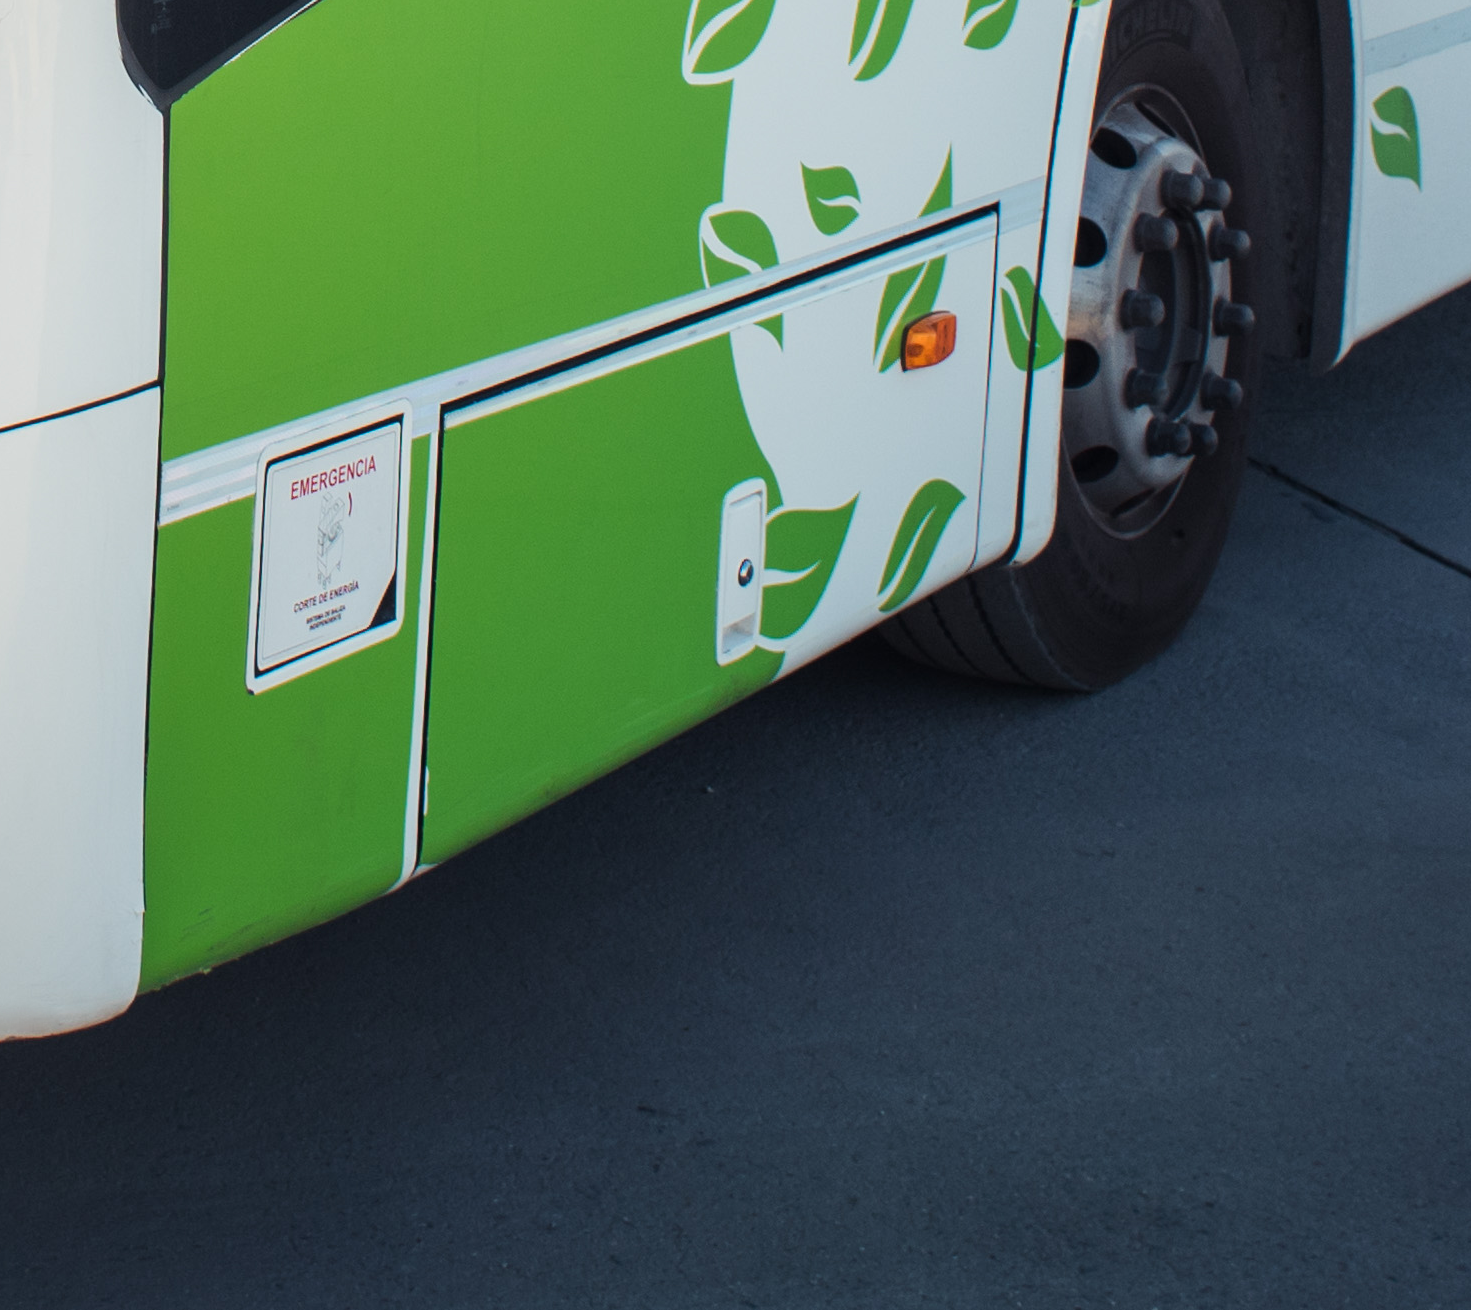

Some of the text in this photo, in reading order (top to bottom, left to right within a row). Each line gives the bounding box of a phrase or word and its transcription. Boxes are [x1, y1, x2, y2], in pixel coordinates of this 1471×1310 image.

[290, 455, 377, 500] EMERGENCIA
[293, 596, 317, 613] CORTE
[318, 591, 328, 604] DE
